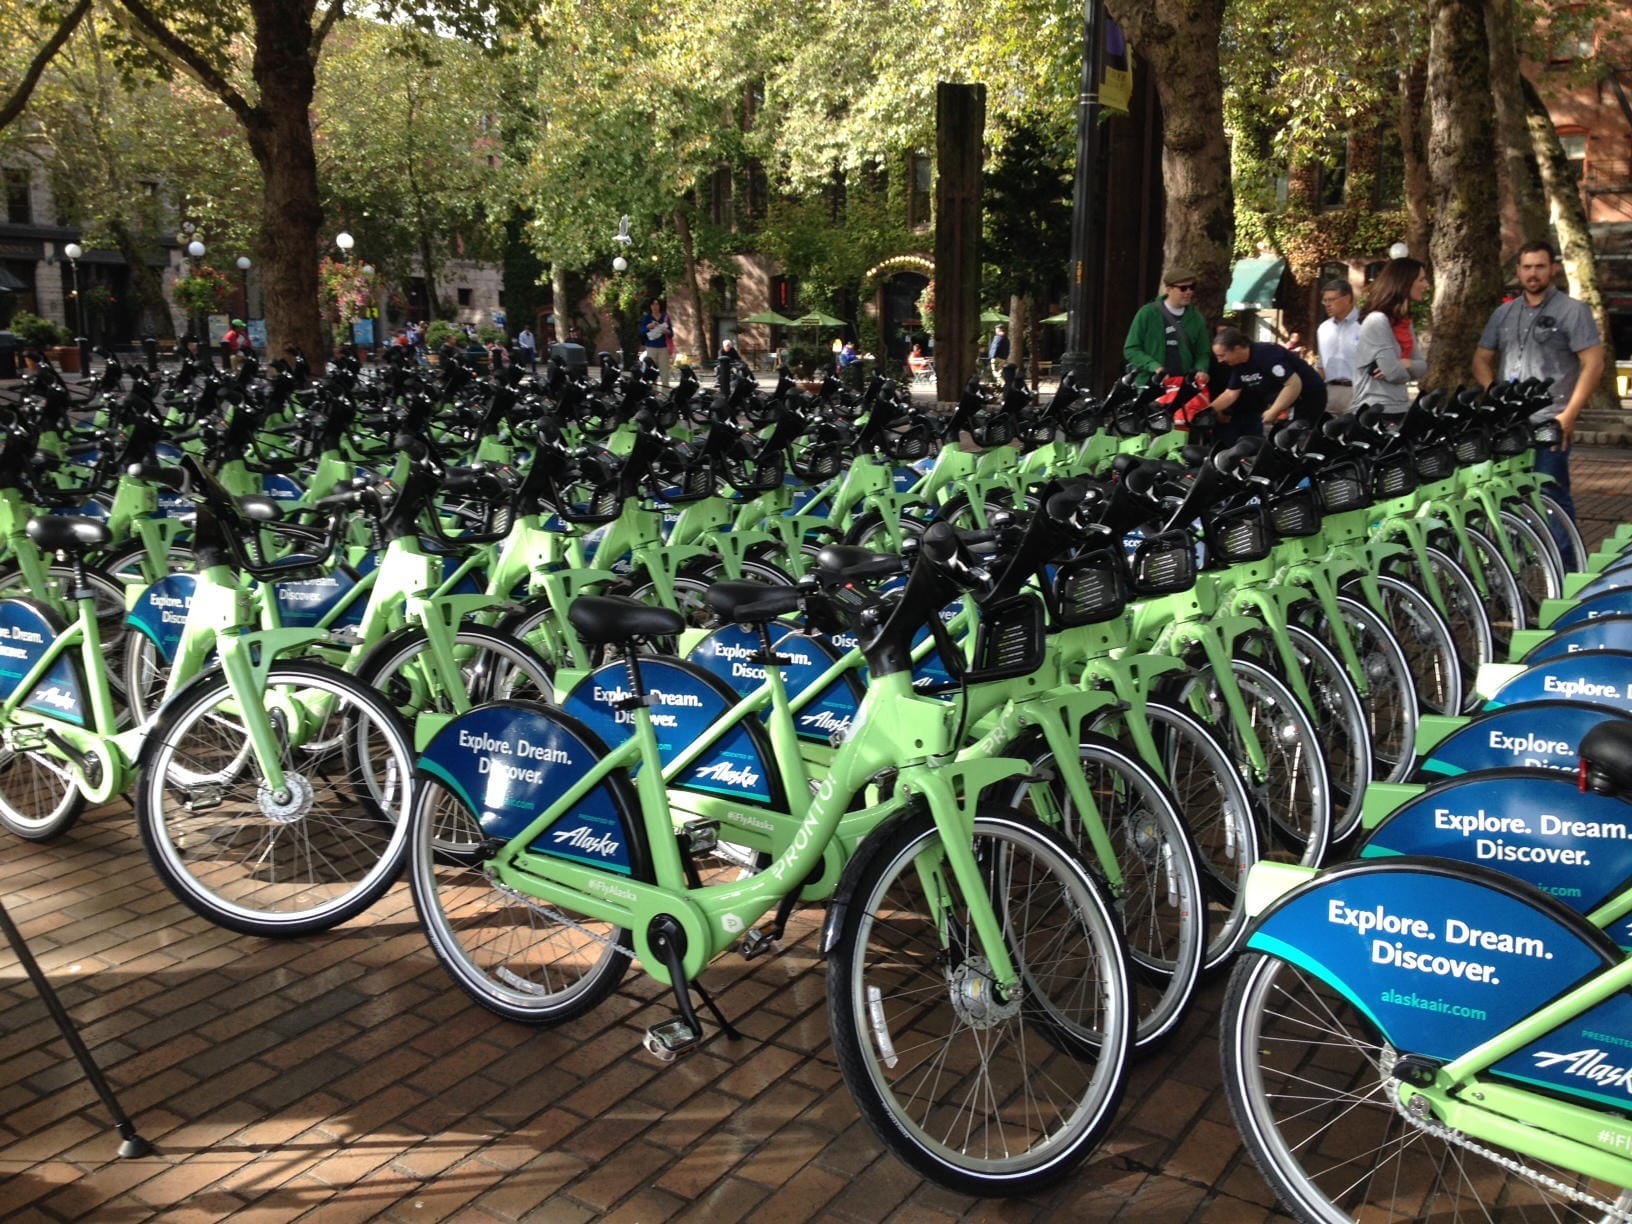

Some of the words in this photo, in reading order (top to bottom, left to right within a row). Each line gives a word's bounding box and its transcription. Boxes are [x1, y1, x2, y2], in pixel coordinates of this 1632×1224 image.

[1544, 675, 1621, 699] Explore.
[459, 729, 513, 754] Explore.
[517, 740, 572, 765] Dream.
[1489, 730, 1574, 757] Explore.
[695, 761, 759, 788] Alaska
[772, 772, 838, 881] PRONTO!
[1434, 809, 1532, 837] Explore.
[1540, 814, 1632, 840] Dream.
[552, 826, 620, 857] Alaska
[1476, 839, 1590, 866] Discover.
[1328, 899, 1436, 940] Explore.
[1445, 919, 1553, 960] Dream.
[1372, 939, 1500, 985] Discover.
[1381, 988, 1487, 1022] alaskaair.com
[1532, 1049, 1632, 1094] Alask
